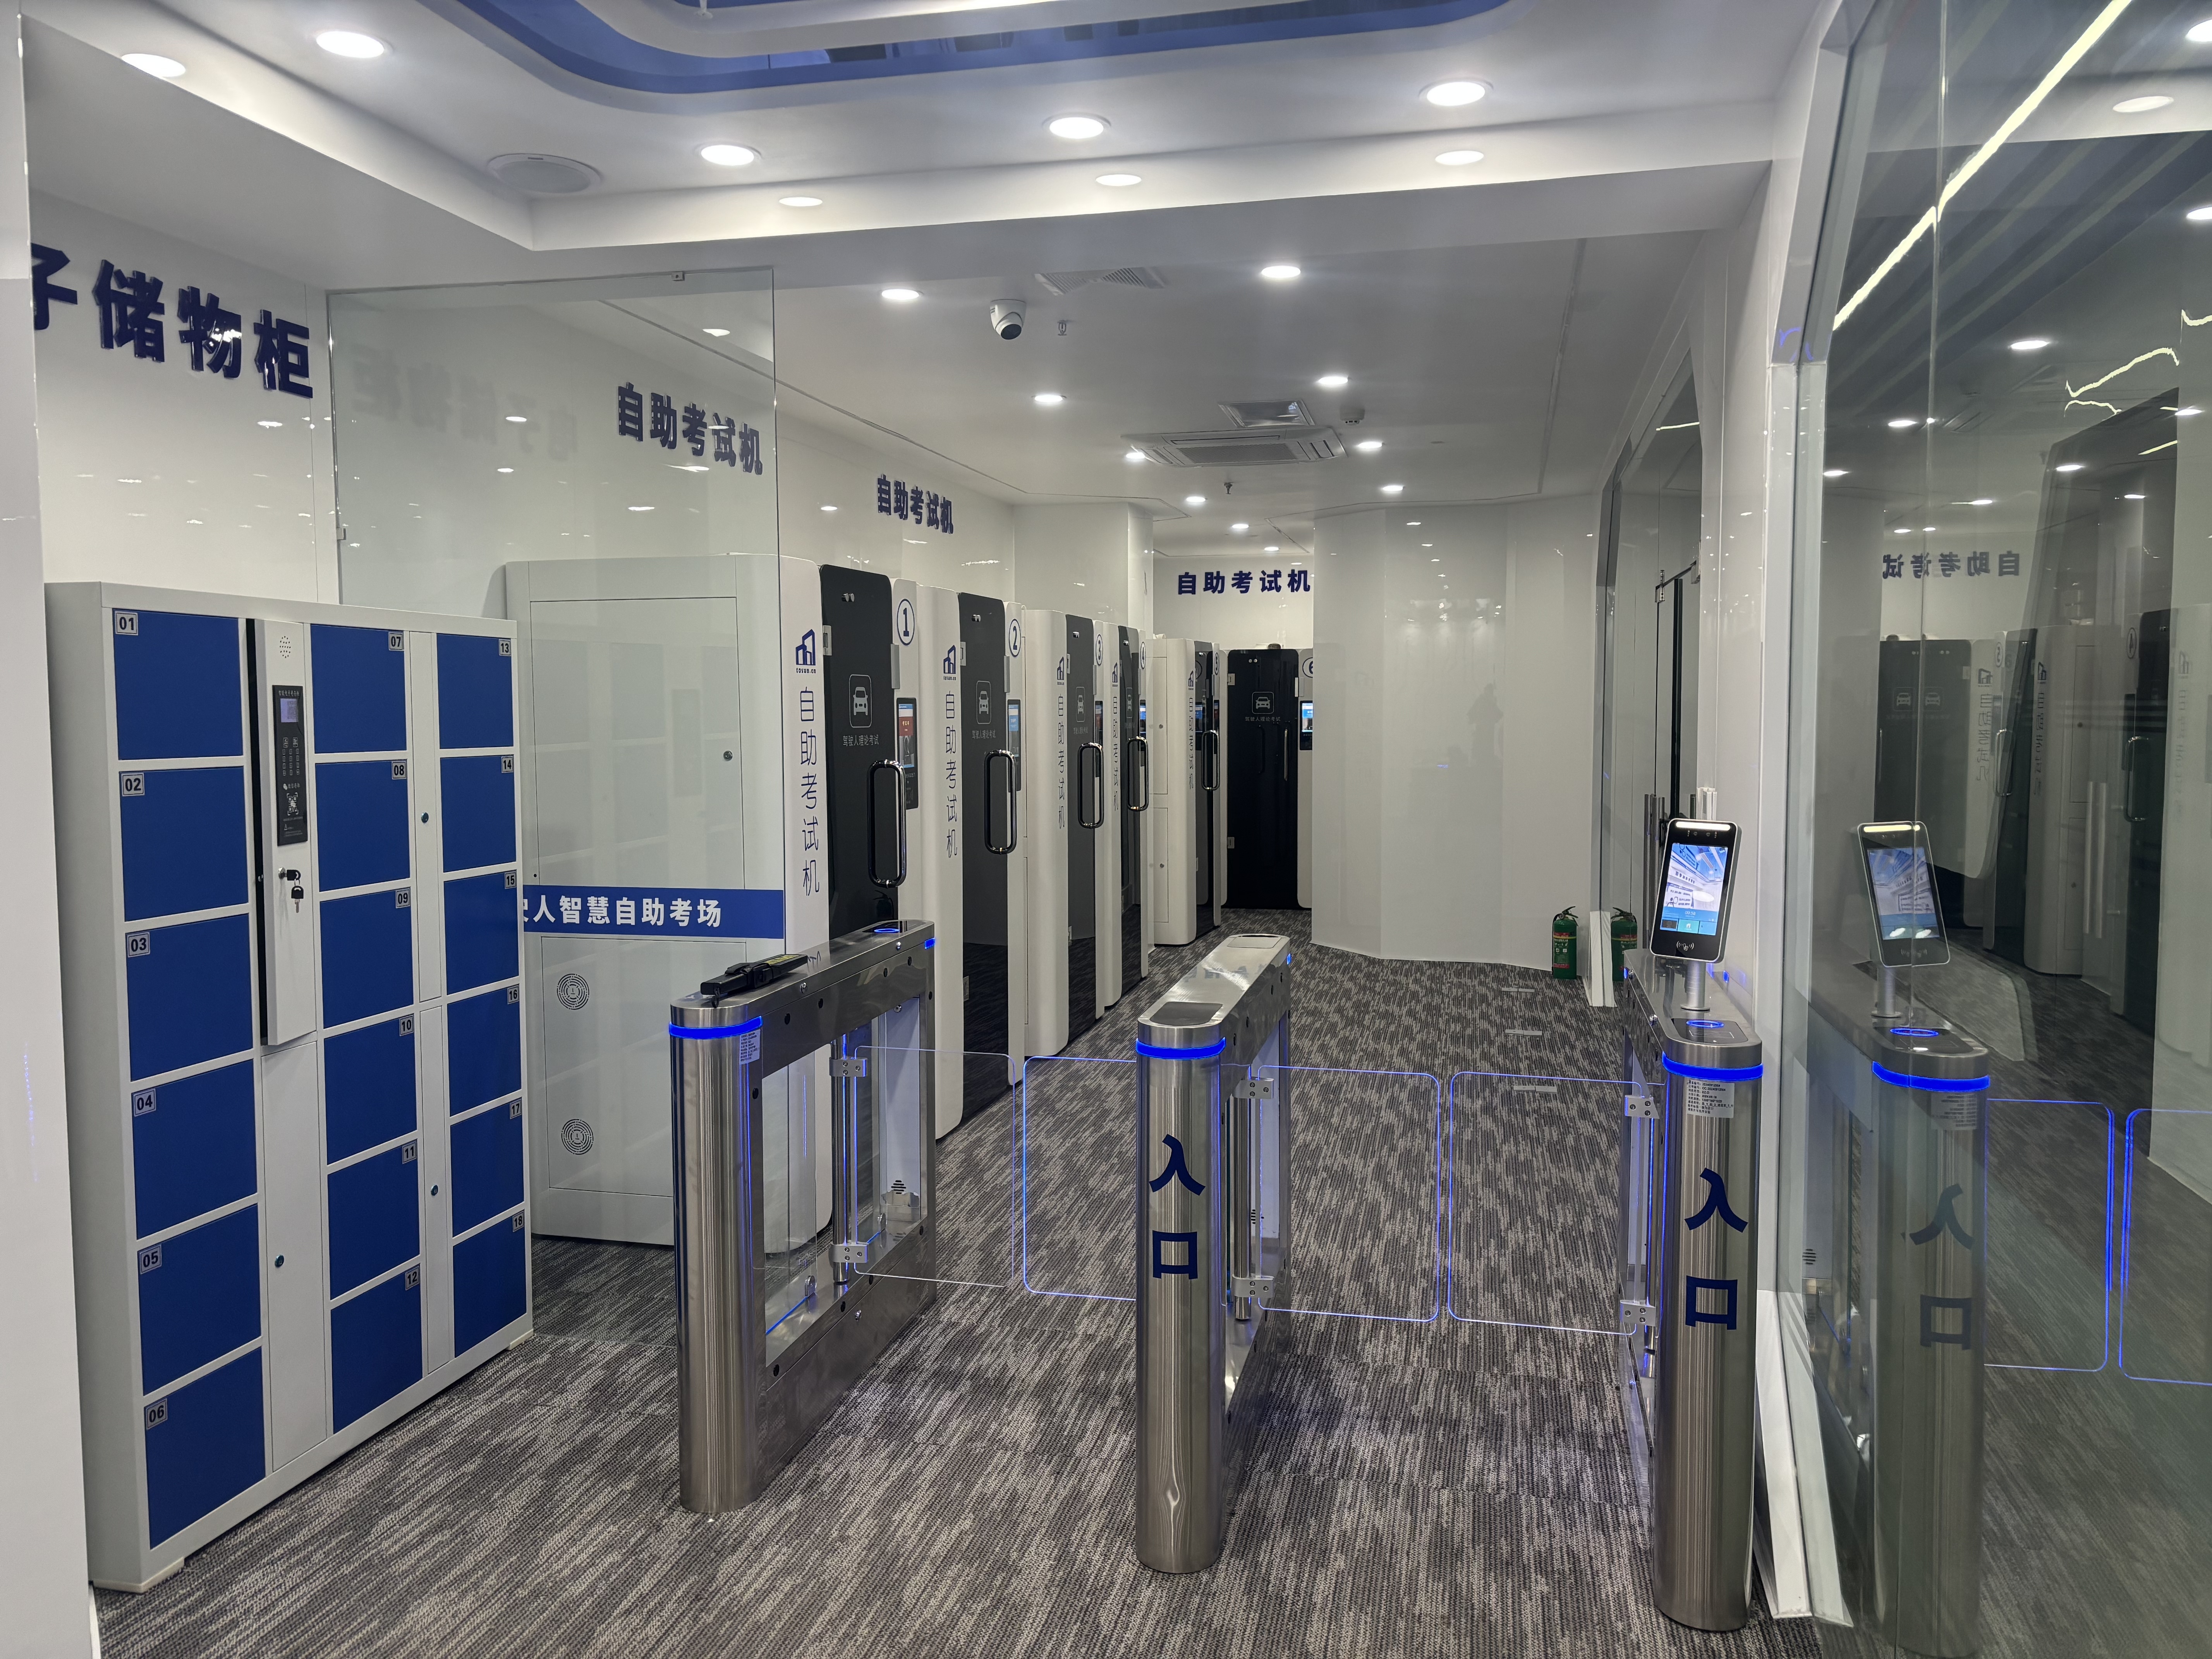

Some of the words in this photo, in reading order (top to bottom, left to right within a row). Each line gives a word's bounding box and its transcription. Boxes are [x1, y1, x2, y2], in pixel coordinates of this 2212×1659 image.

[618, 382, 763, 475] 自助考试机
[878, 474, 954, 534] 自助考试机
[1178, 569, 1310, 594] 自助考试机
[119, 617, 134, 630] 01
[903, 608, 909, 637] 1
[391, 636, 401, 647] 07
[1013, 626, 1017, 650] 2
[501, 643, 509, 653] 13
[1098, 640, 1101, 660] 3
[394, 764, 404, 776] 08
[503, 759, 512, 770] 14
[945, 691, 958, 858] 自助考试机
[125, 778, 141, 792] 02
[800, 687, 819, 896] 自助考试机
[507, 875, 515, 886] 15
[398, 893, 408, 904] 09
[131, 938, 146, 952] 03
[509, 989, 517, 1000] 16
[402, 1019, 412, 1032] 10
[137, 1094, 153, 1111] 04
[512, 1103, 520, 1115] 17
[405, 1146, 414, 1159] 11
[1149, 1134, 1206, 1279] 入口
[514, 1215, 522, 1228] 18
[1685, 1167, 1748, 1330] 入口
[143, 1250, 158, 1268] 05
[407, 1271, 417, 1285] 12
[149, 1405, 164, 1423] 06
